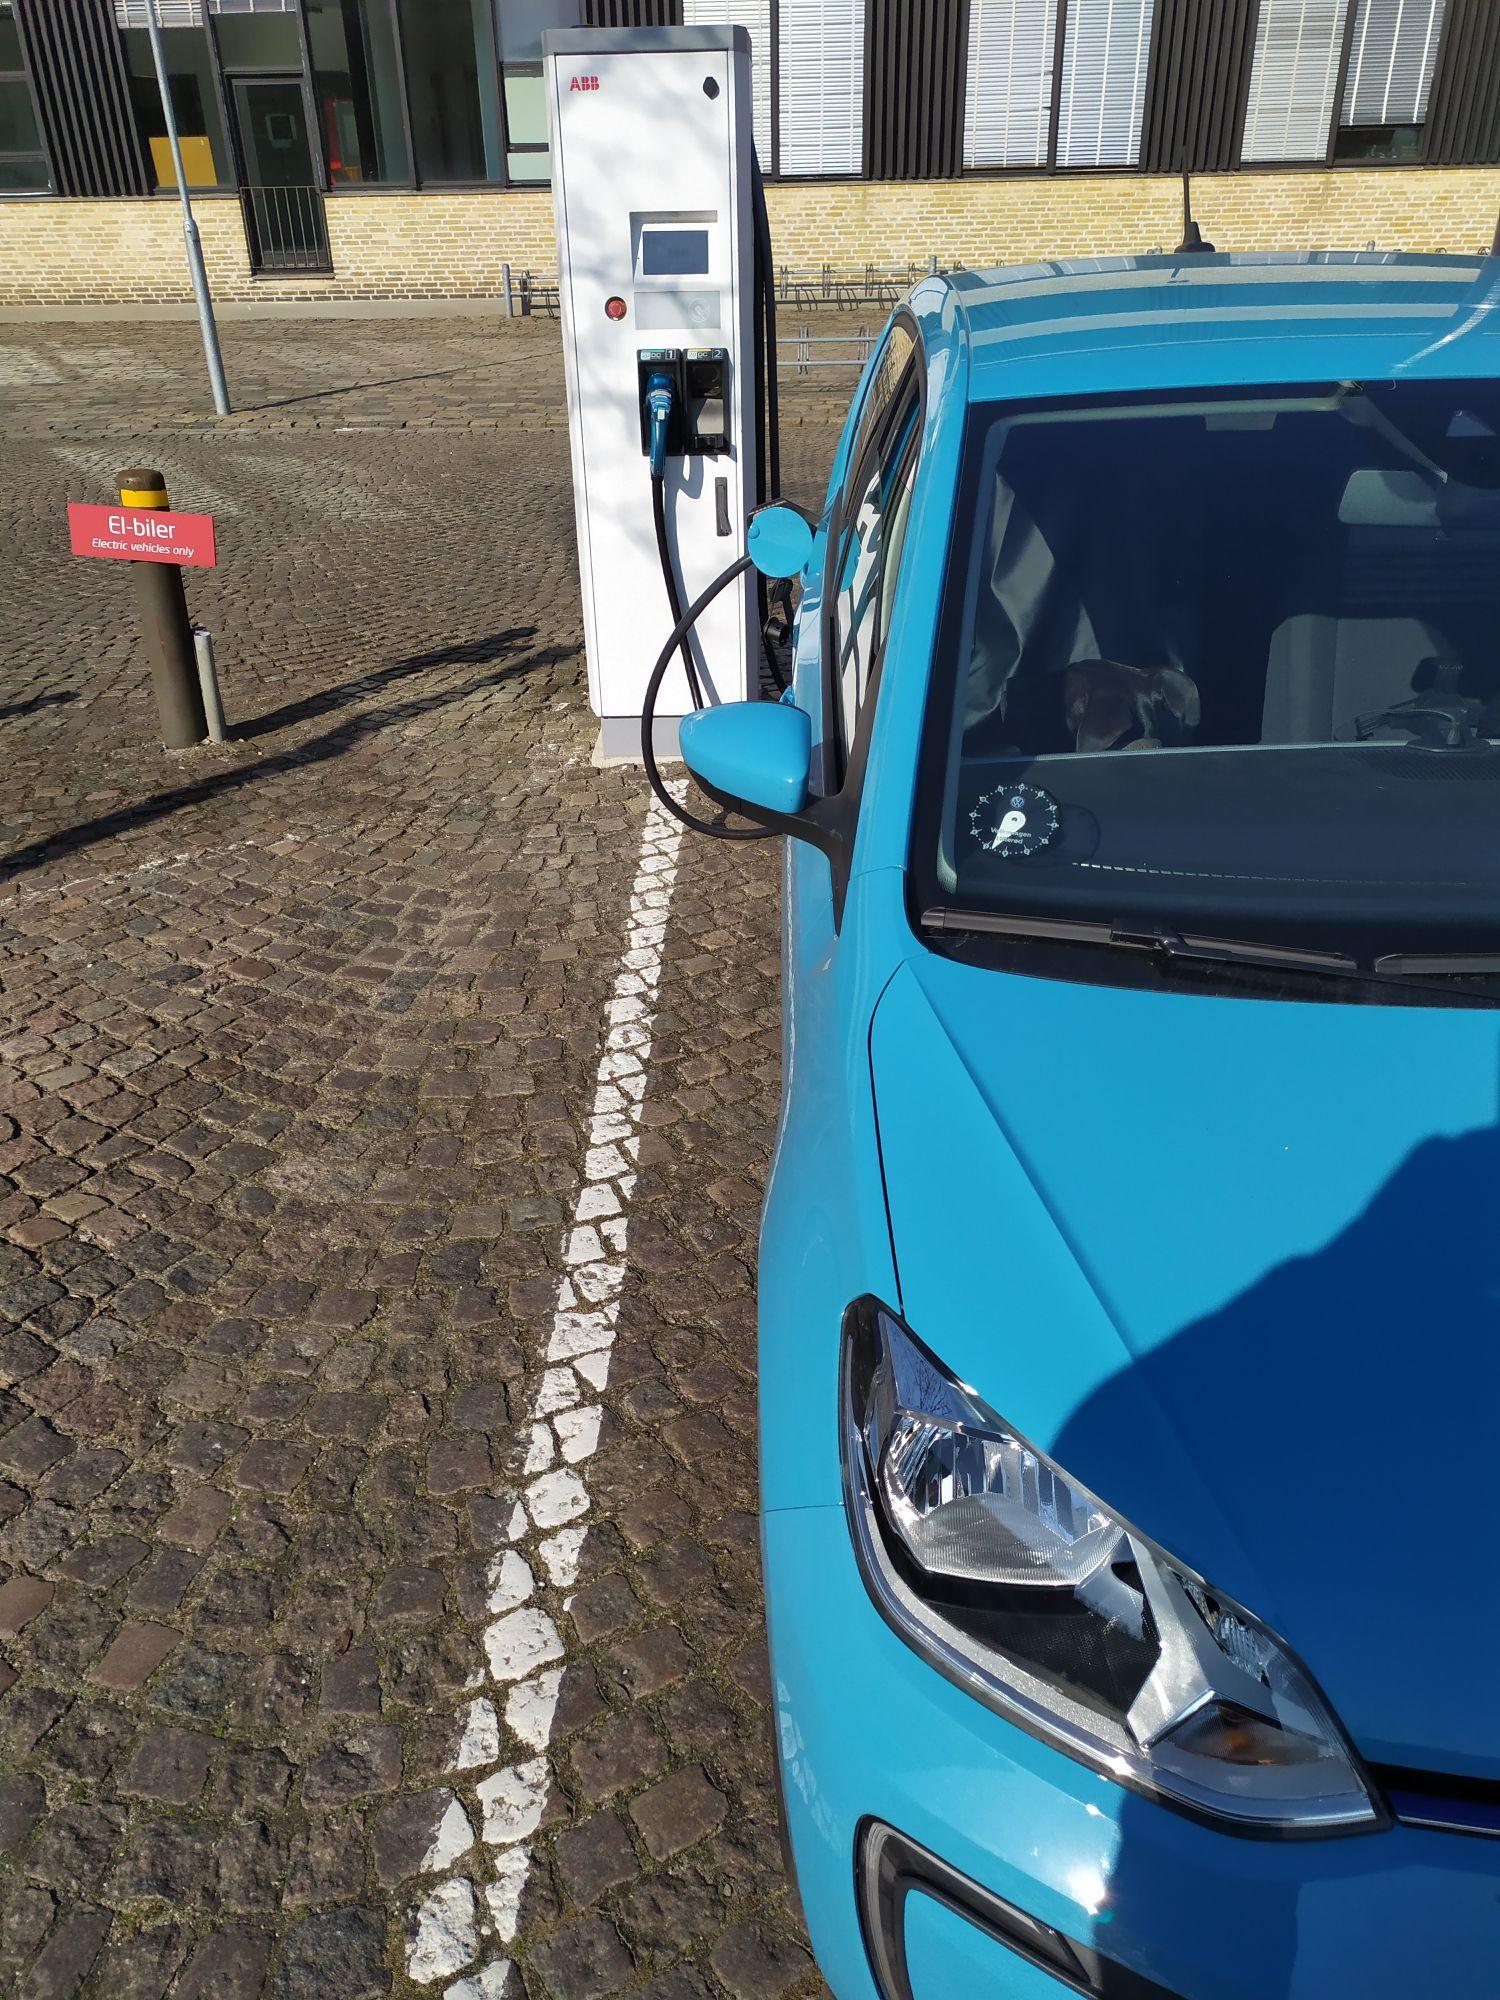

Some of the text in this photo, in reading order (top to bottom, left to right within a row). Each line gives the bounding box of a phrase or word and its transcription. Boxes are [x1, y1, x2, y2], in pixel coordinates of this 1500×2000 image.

[569, 76, 600, 92] ABB
[108, 515, 176, 539] El-biler
[91, 538, 195, 558] Electric vehicles only
